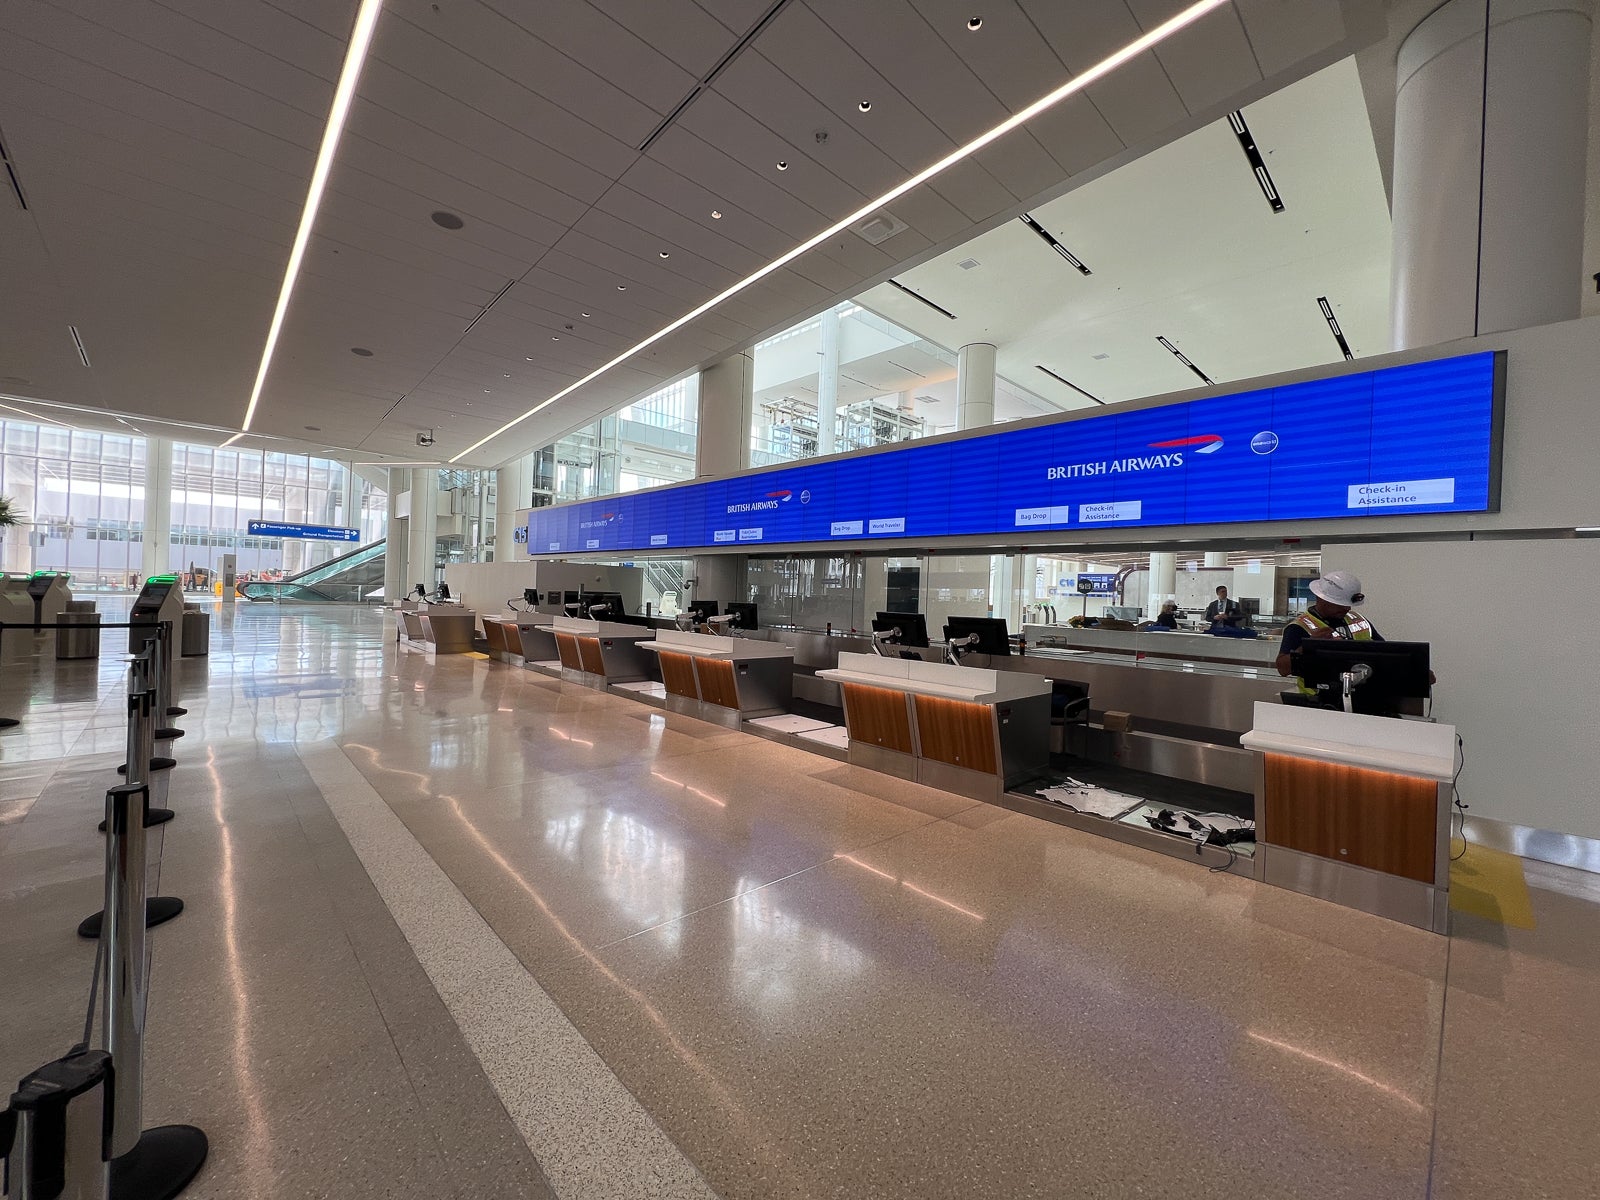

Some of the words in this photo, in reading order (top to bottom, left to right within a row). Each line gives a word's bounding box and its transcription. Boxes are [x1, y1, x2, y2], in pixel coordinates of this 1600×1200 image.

[1047, 461, 1106, 480] BRITISH
[1109, 452, 1184, 474] AIRWAYS
[1358, 484, 1406, 495] Check-in
[1358, 495, 1417, 505] Assistance
[727, 503, 750, 514] BRITISH
[751, 500, 778, 511] AIRWAYS
